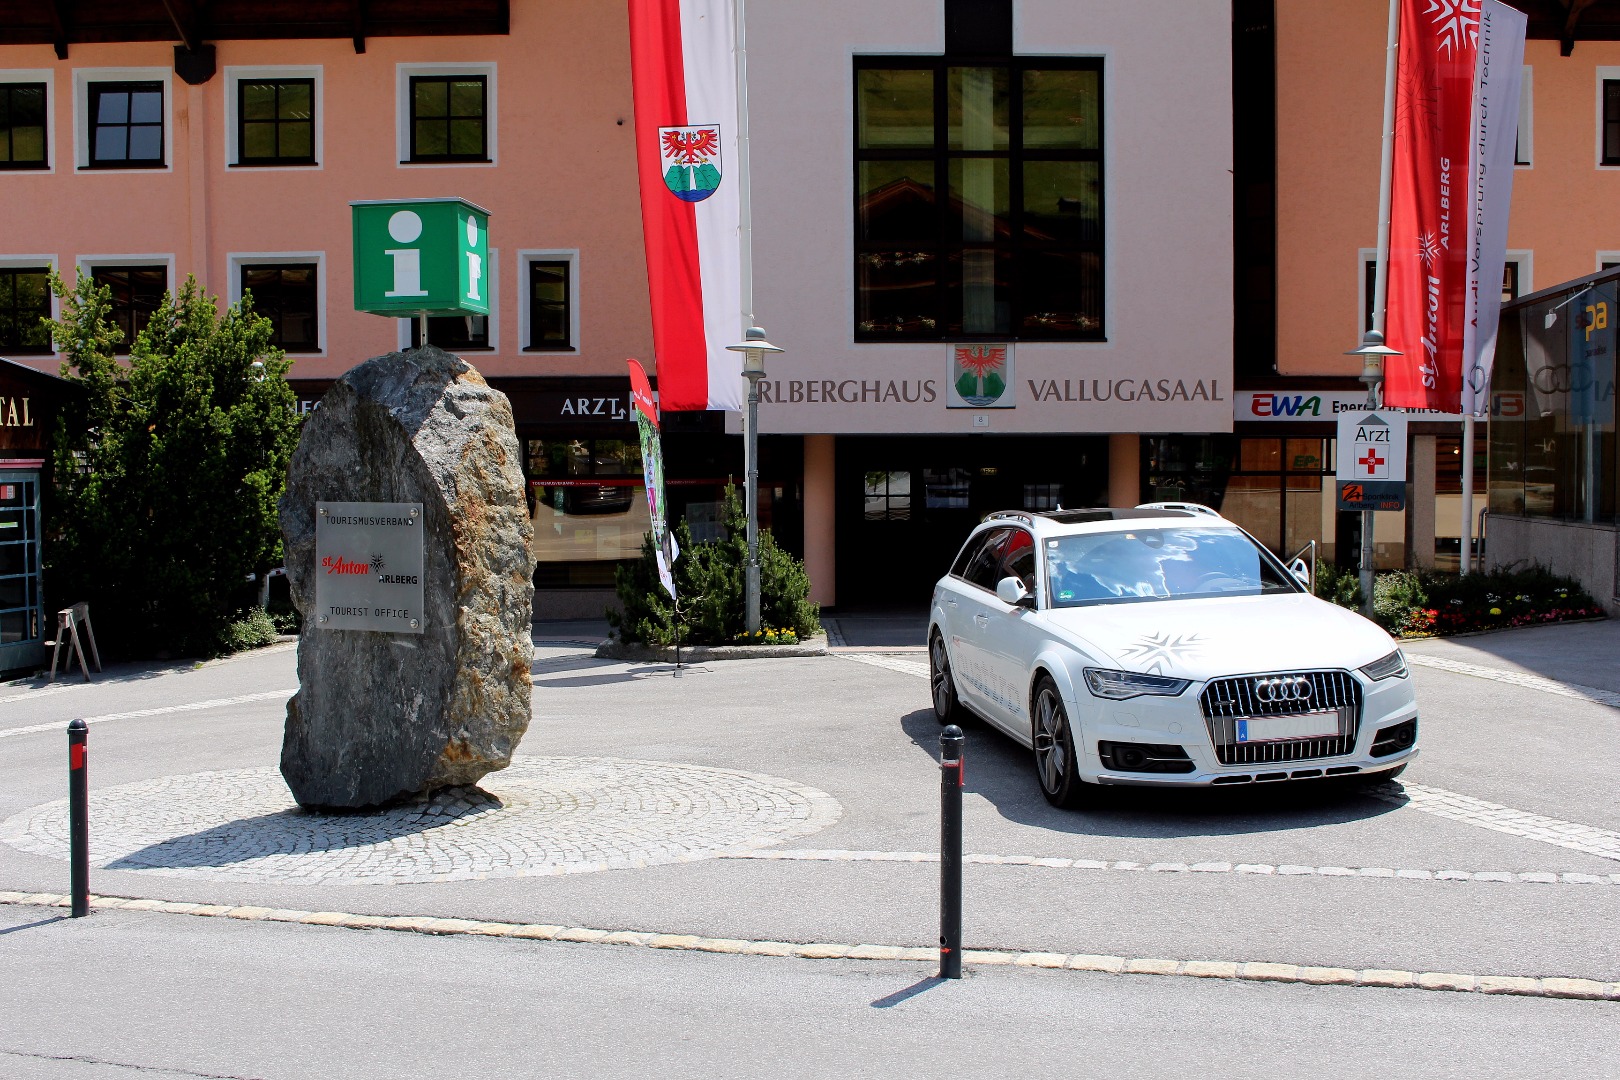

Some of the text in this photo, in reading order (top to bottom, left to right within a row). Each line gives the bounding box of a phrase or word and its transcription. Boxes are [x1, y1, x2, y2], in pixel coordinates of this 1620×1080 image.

[1471, 162, 1486, 273] Vorsprung
[1479, 97, 1487, 155] durch
[1438, 157, 1451, 250] ARLBERG
[756, 380, 937, 403] RLBERGHAUS
[1027, 378, 1224, 402] VALLUGASAAL
[560, 397, 620, 415] ARZT
[1251, 393, 1322, 417] EWA
[1355, 426, 1391, 442] Arzt
[1380, 501, 1400, 509] INFO
[325, 516, 414, 527] TOURISMUSVERBAND
[378, 574, 418, 585] ARLBERG
[330, 606, 409, 619] TOURIST OFFICE
